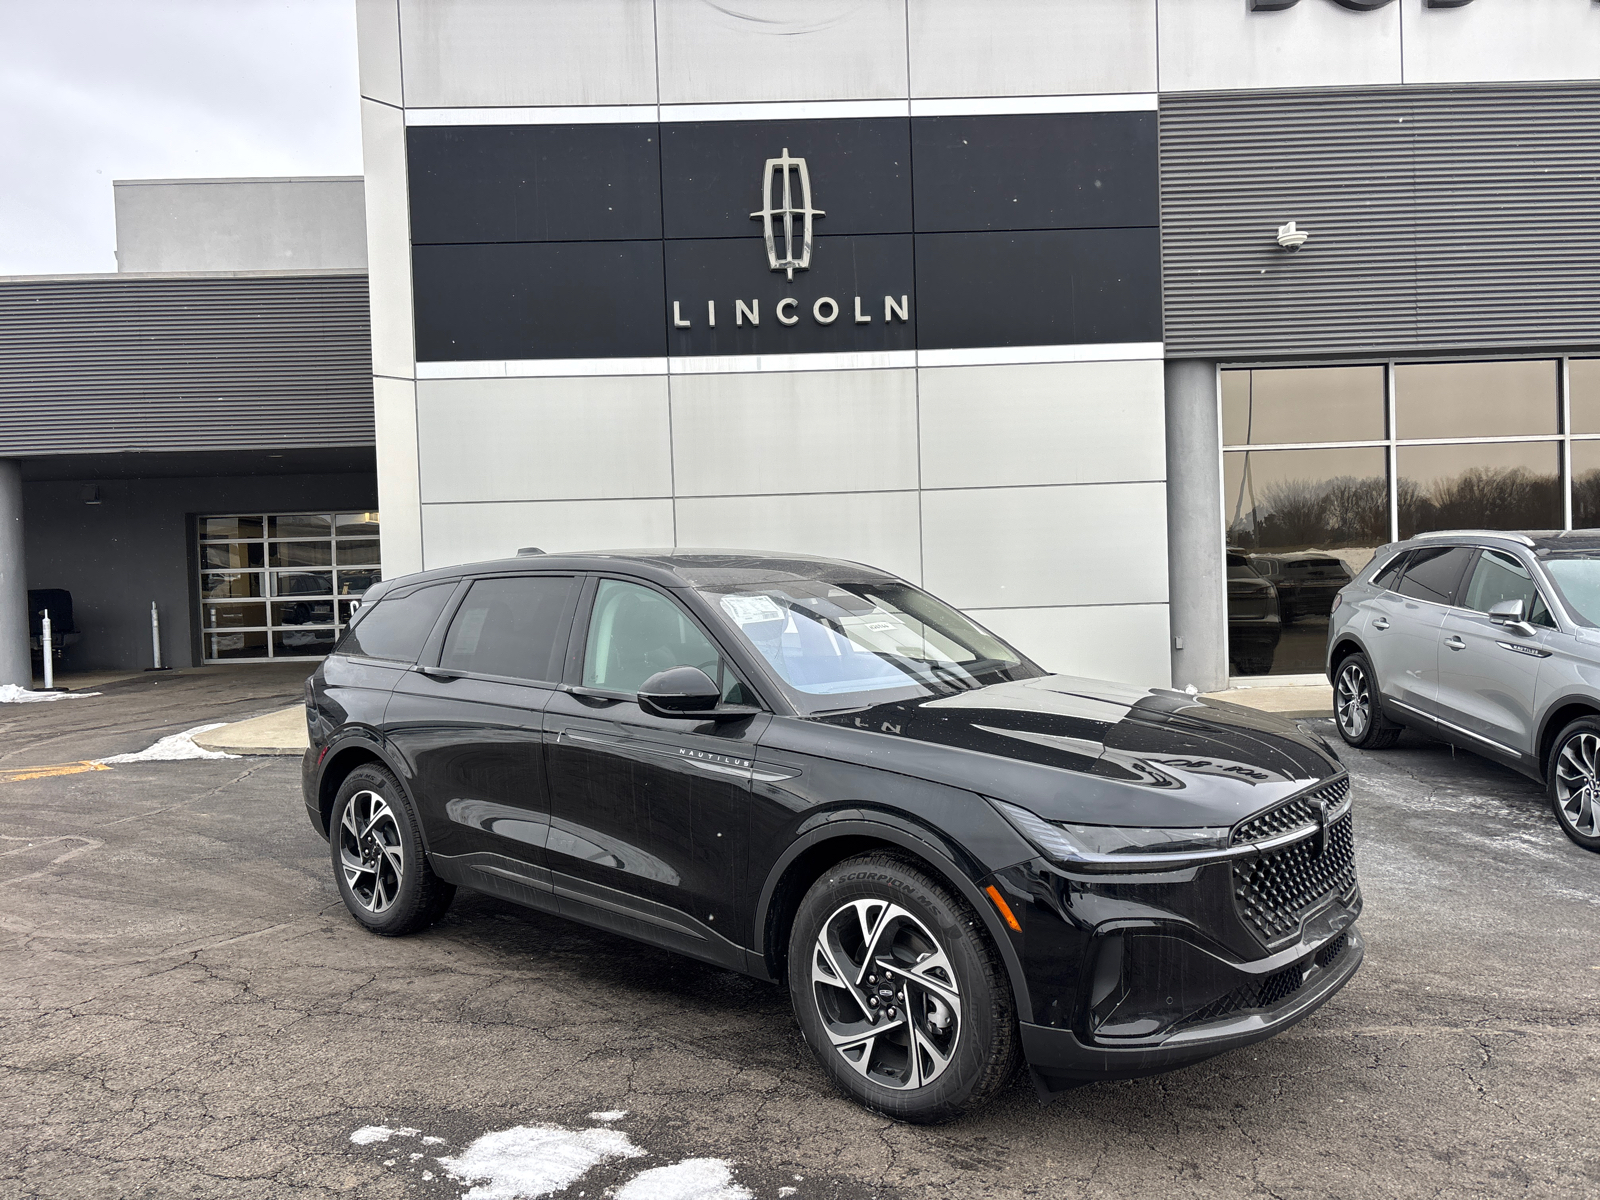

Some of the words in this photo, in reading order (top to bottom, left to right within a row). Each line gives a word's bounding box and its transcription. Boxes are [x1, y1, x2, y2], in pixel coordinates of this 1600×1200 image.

[673, 295, 909, 328] LINCOLN
[679, 748, 750, 767] NAUTILUS
[838, 871, 916, 895] SCORPION
[916, 895, 942, 917] MS
